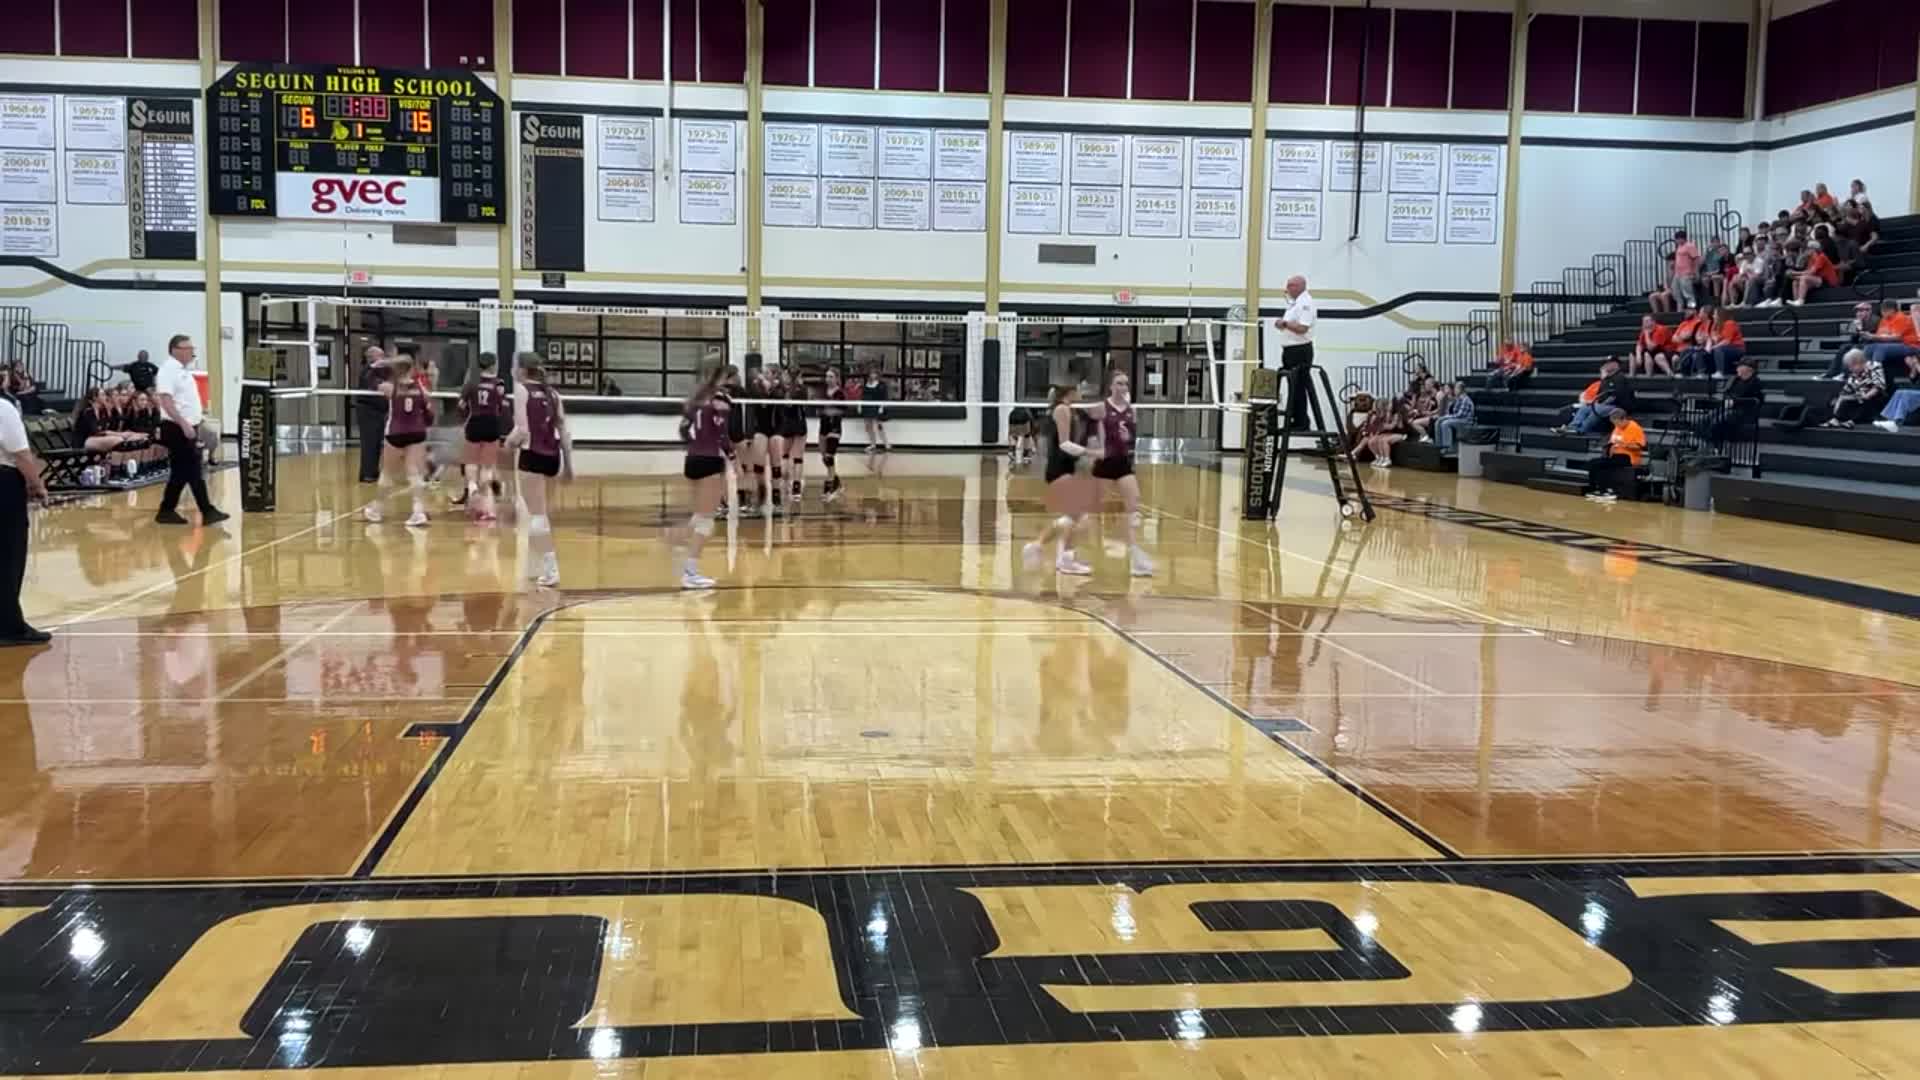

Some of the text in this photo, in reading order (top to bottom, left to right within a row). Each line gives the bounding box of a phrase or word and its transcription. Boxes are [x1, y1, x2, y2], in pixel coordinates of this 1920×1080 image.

[236, 72, 476, 97] SEGUIN HIGH SCHOOL
[130, 99, 191, 128] SEGUIN
[282, 94, 315, 105] SEGUIN
[399, 99, 431, 110] VISITOR
[301, 107, 315, 128] 6
[413, 111, 432, 132] 15
[524, 115, 581, 142] SEGUIN
[131, 145, 142, 255] MATADORS
[311, 178, 407, 214] gvec
[523, 154, 534, 261] MATADORS
[1135, 199, 1177, 210] 2014-15
[248, 393, 264, 497] MATADORS
[1250, 404, 1268, 508] MATADORS
[1263, 435, 1275, 473] SEGUIN
